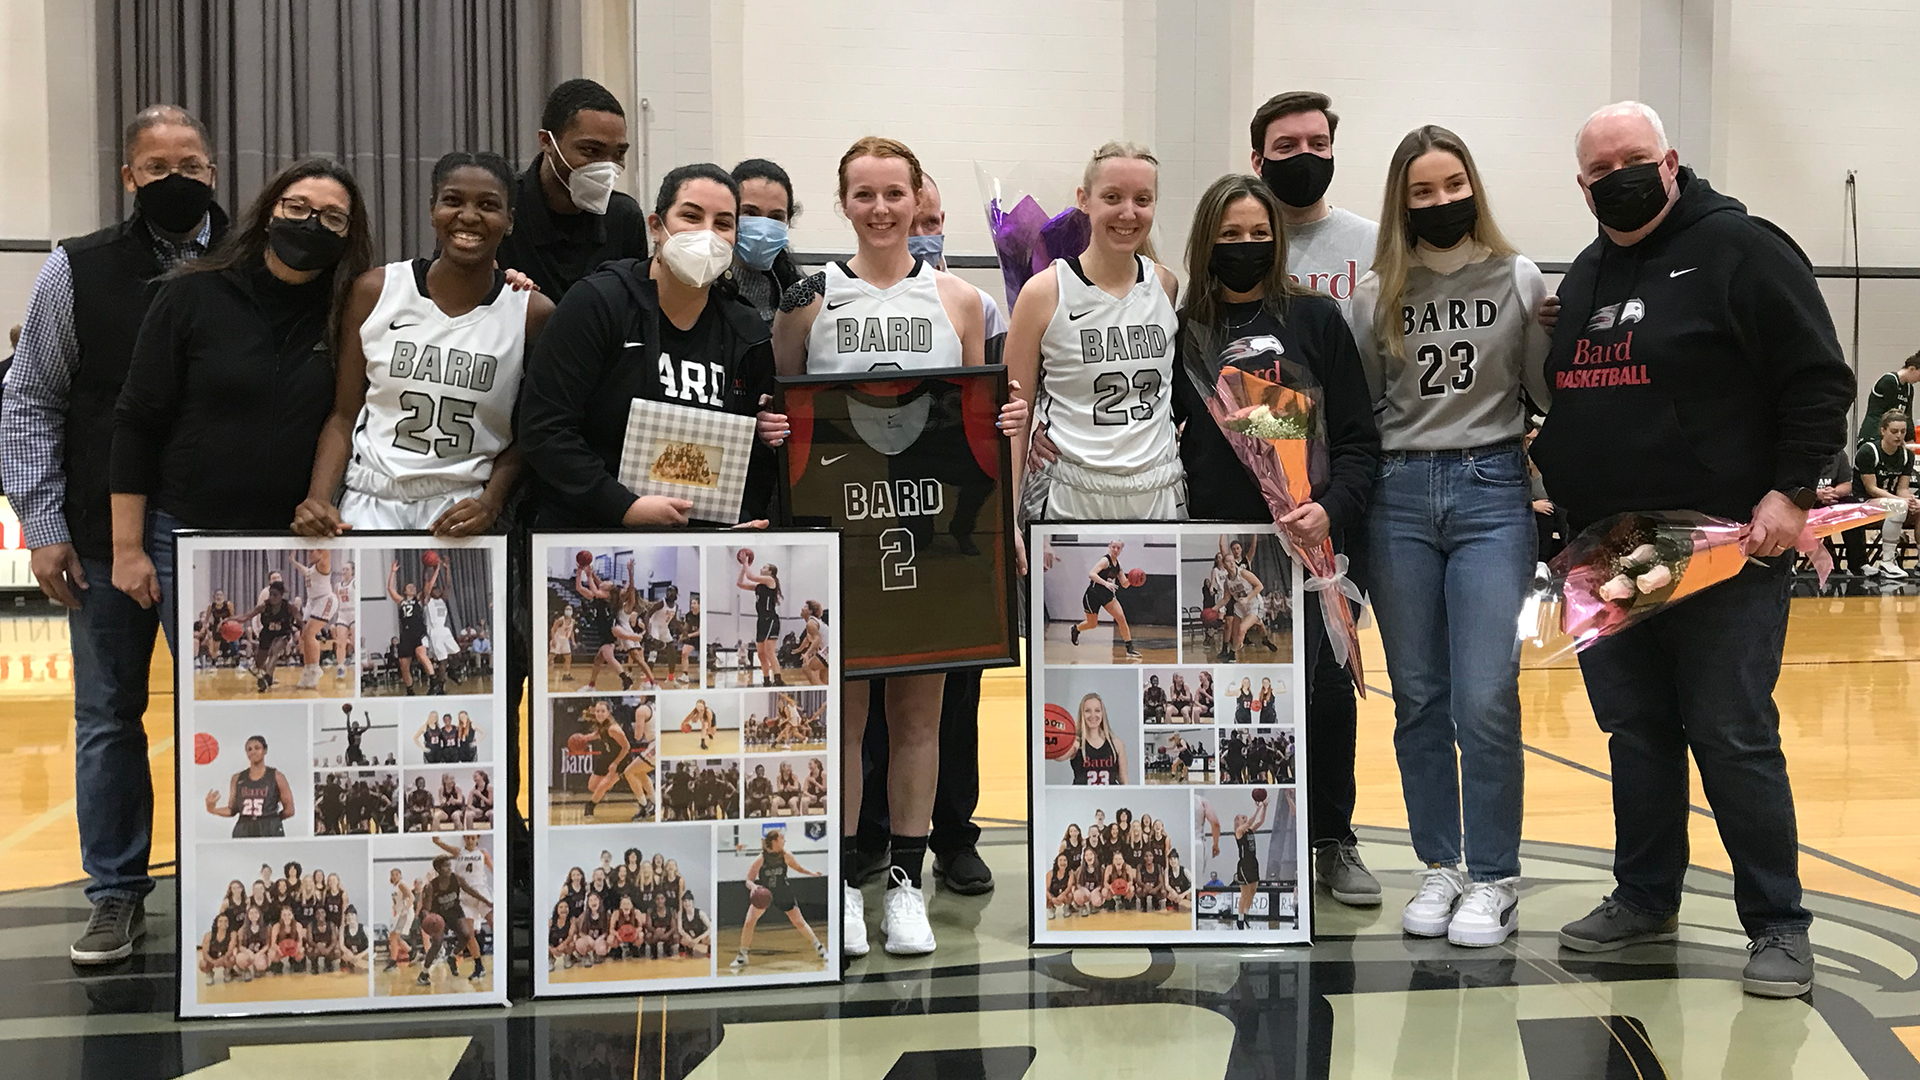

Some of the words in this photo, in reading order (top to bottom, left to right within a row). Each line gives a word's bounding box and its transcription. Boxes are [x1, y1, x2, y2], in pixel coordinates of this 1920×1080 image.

[1288, 259, 1357, 300] rd
[836, 317, 932, 354] BARD
[1402, 298, 1498, 336] BARD
[1080, 324, 1169, 365] BARD
[1573, 331, 1633, 365] Bard
[389, 340, 498, 393] BARD
[658, 352, 726, 408] ARD
[1416, 339, 1478, 400] 23
[1556, 364, 1651, 389] BASKETBALL
[1092, 368, 1162, 426] 23
[392, 390, 475, 459] 25
[843, 477, 944, 521] BARD
[879, 527, 917, 591] 2
[402, 605, 414, 618] 12
[560, 744, 594, 774] Bard
[1083, 755, 1113, 768] Bard
[1086, 770, 1110, 786] 23
[242, 798, 265, 817] 25
[465, 862, 473, 874] 4
